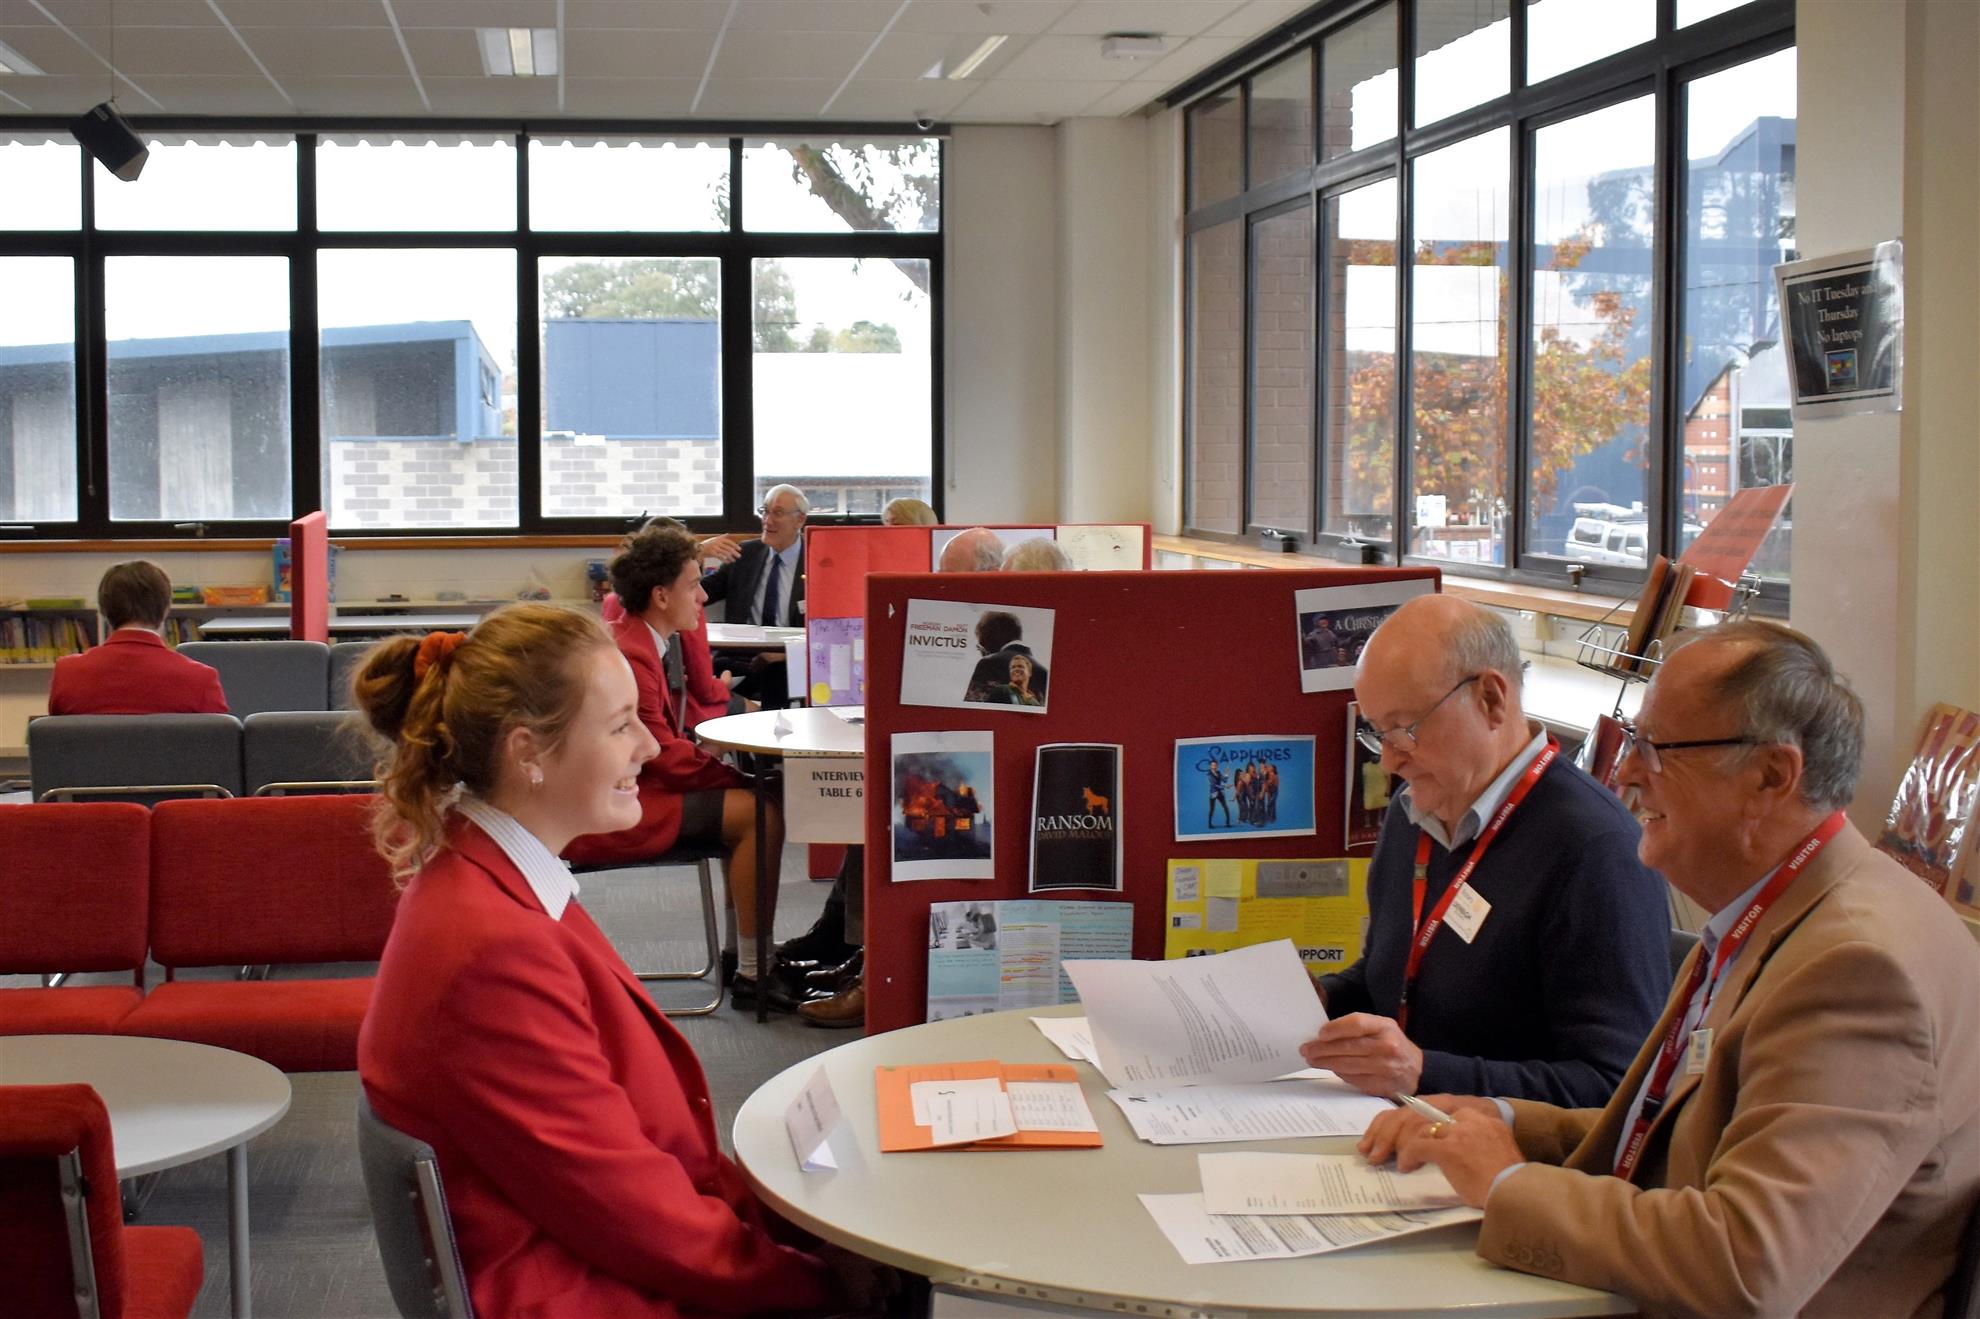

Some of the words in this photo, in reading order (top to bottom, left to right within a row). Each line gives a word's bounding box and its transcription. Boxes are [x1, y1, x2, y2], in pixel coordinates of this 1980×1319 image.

[1798, 292, 1810, 304] No
[1811, 287, 1823, 303] IT
[1824, 283, 1859, 301] Tuesday
[1818, 305, 1859, 323] Thursday
[1817, 330, 1830, 343] No
[1831, 328, 1863, 344] laptops
[910, 624, 941, 632] FREEMAN
[943, 625, 968, 633] DAMON
[1334, 619, 1342, 631] A
[909, 634, 967, 649] INVICTUS
[1196, 746, 1292, 772] SAPPHIRES
[1532, 750, 1555, 775] VISITOR
[819, 787, 853, 798] TABLE
[855, 787, 863, 798] 6
[1037, 814, 1113, 832] RANSOM
[1491, 802, 1515, 831] VISITOR
[1787, 838, 1822, 870] VISITOR
[1453, 861, 1475, 889] VISITOR
[1732, 904, 1763, 939] VISITOR
[1419, 919, 1439, 948] VISITOR
[1299, 949, 1344, 960] PPORT
[1622, 1132, 1644, 1170] VISITOR
